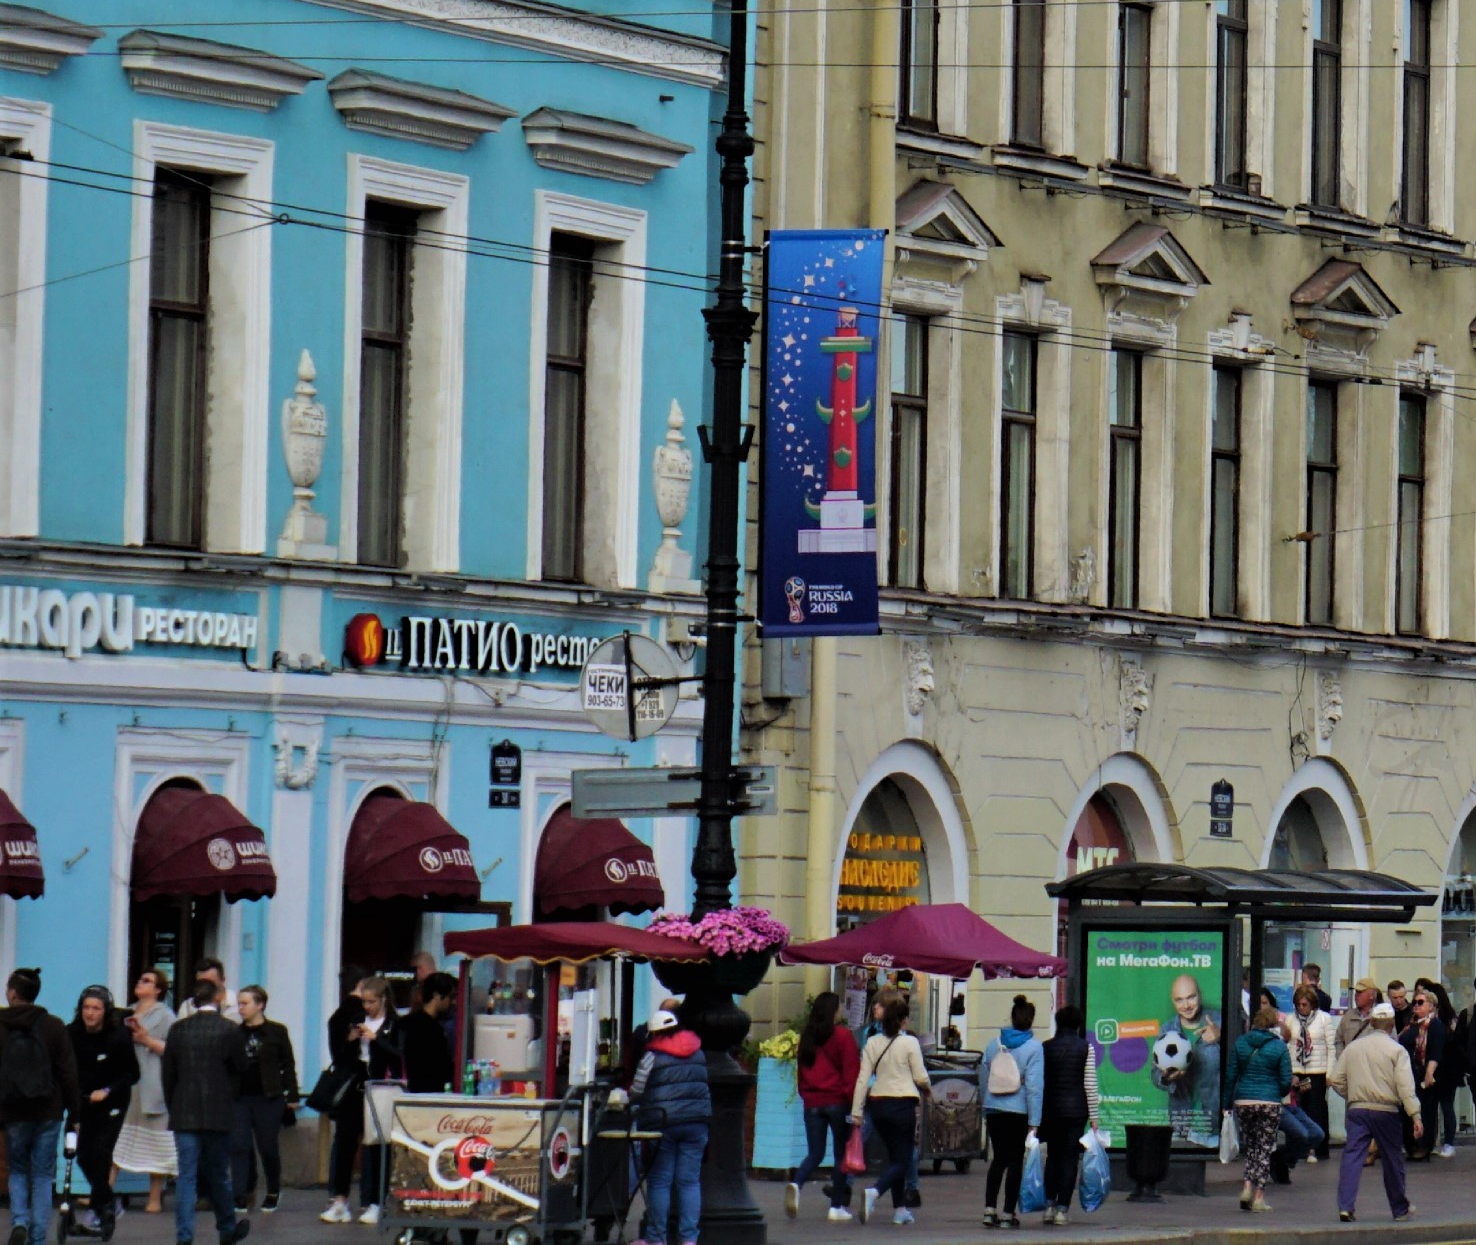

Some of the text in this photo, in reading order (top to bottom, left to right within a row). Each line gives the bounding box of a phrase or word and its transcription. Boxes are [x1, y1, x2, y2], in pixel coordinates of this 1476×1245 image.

[809, 590, 853, 602] RUSSIA
[810, 603, 838, 613] 2018
[139, 607, 259, 648] РЕСТОРАН
[407, 616, 522, 672] ПАТИО
[588, 675, 624, 693] ЧЕКИ
[587, 694, 625, 707] 903-65-73
[849, 834, 920, 851] ОДАРКИ
[1097, 937, 1217, 954] Смотри футбол
[1096, 954, 1212, 968] на МегаФон.ТВ
